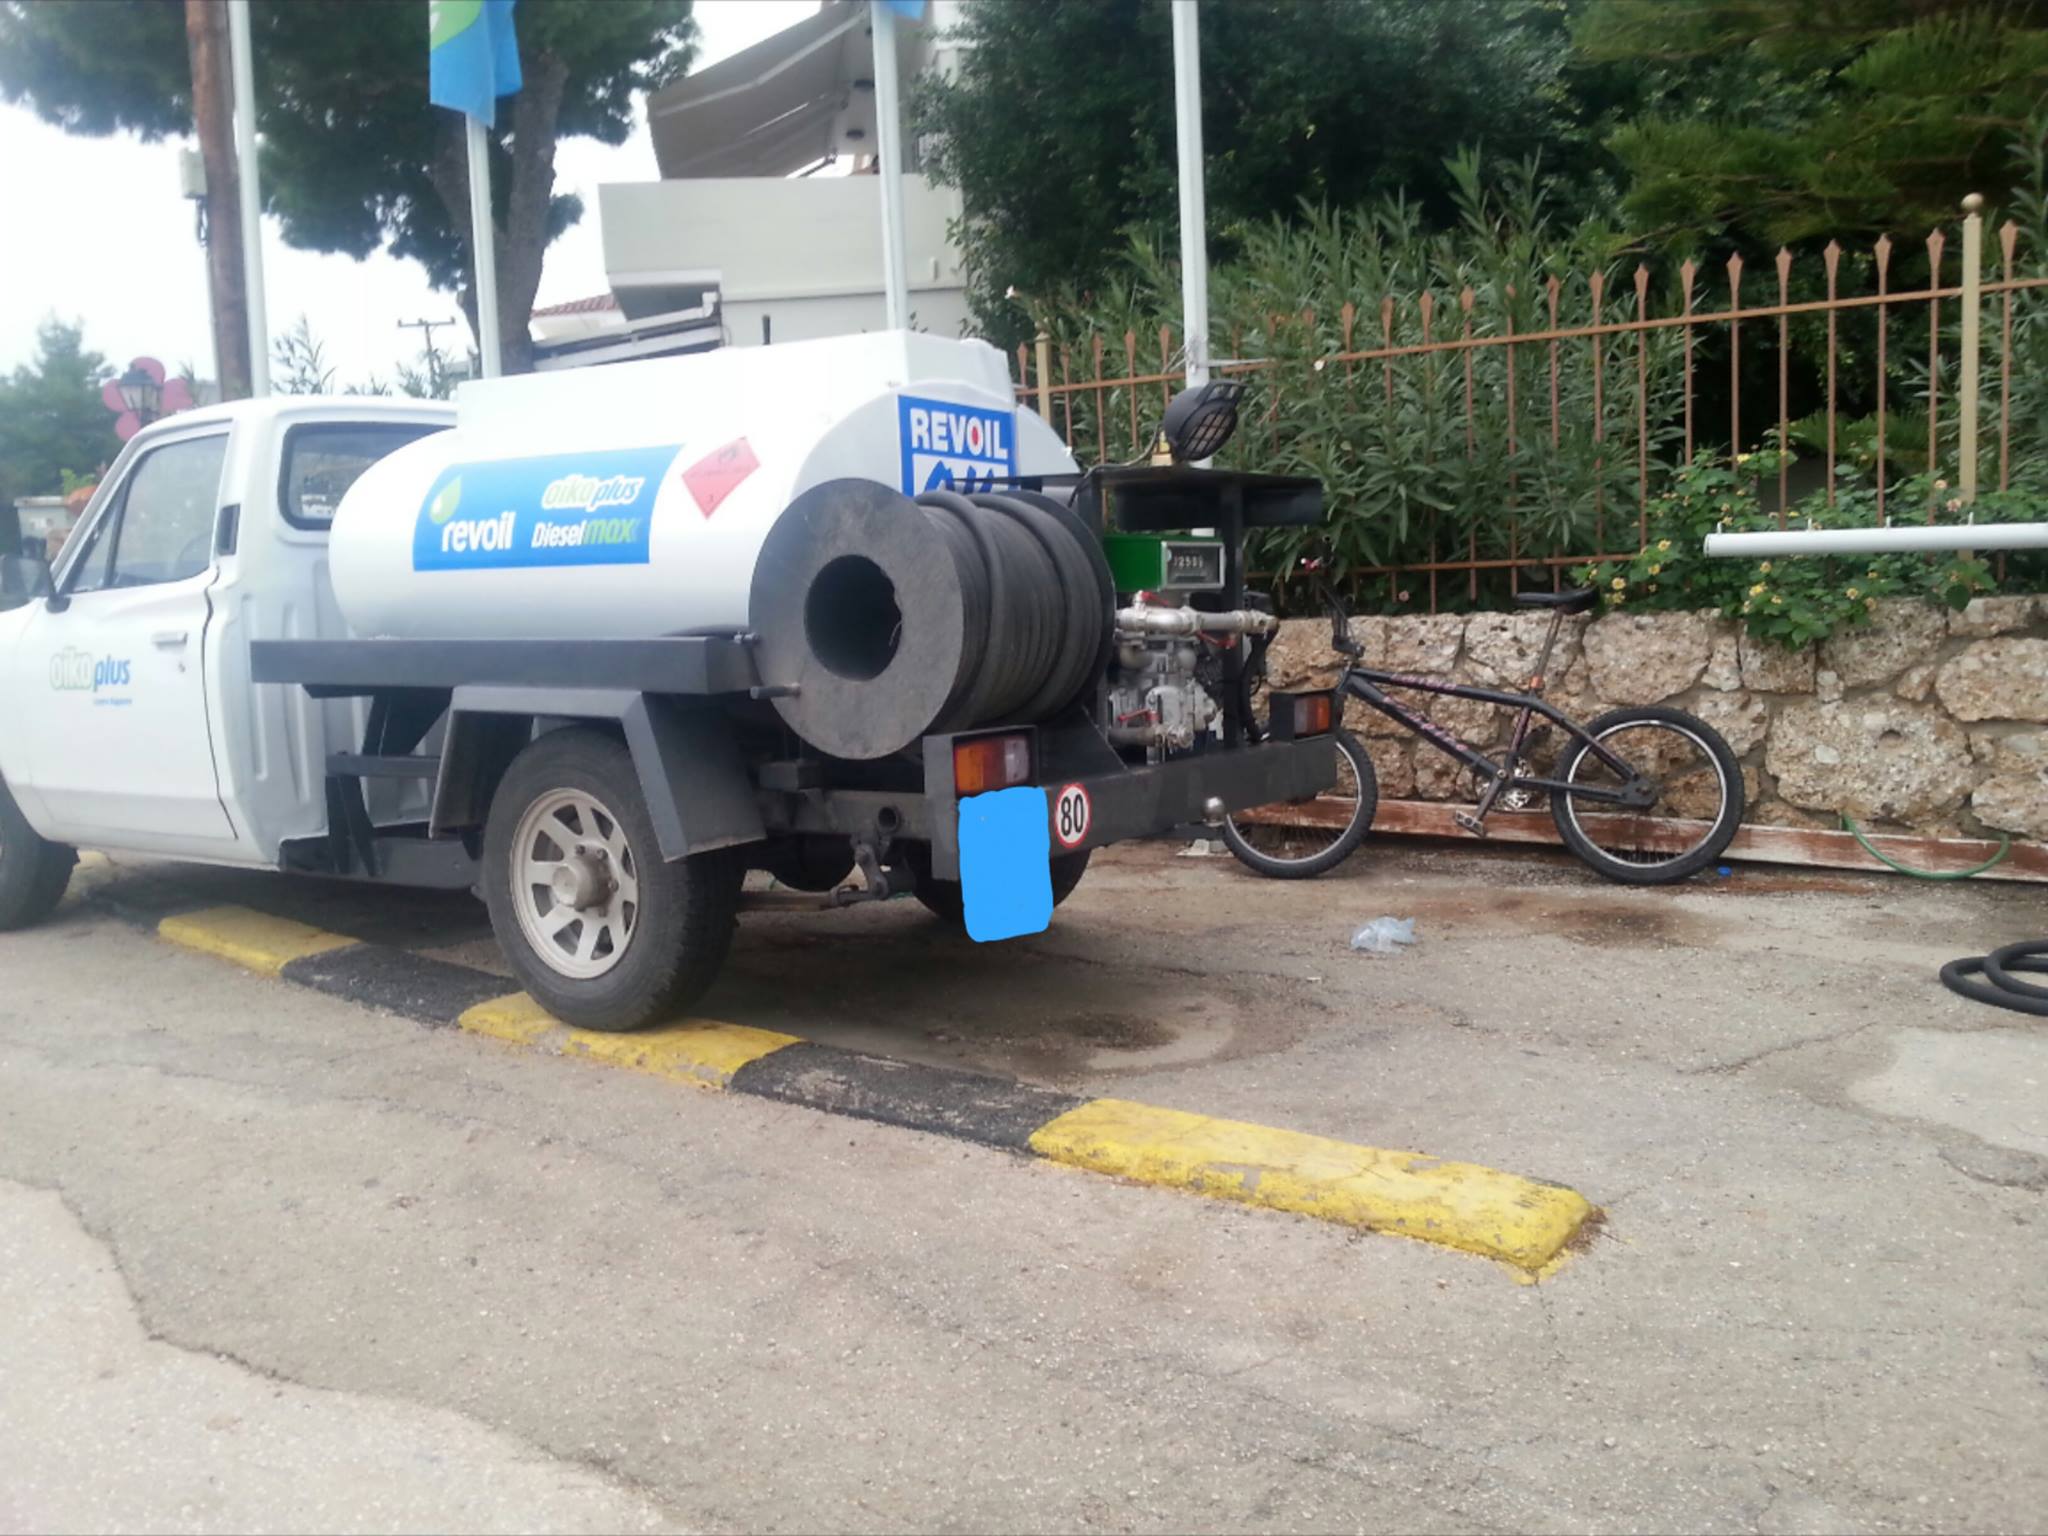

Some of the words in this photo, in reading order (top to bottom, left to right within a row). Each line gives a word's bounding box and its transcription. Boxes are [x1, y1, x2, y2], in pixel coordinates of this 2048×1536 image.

[910, 407, 1009, 460] REVOIL
[441, 510, 517, 552] revoil
[1061, 793, 1084, 837] 80
